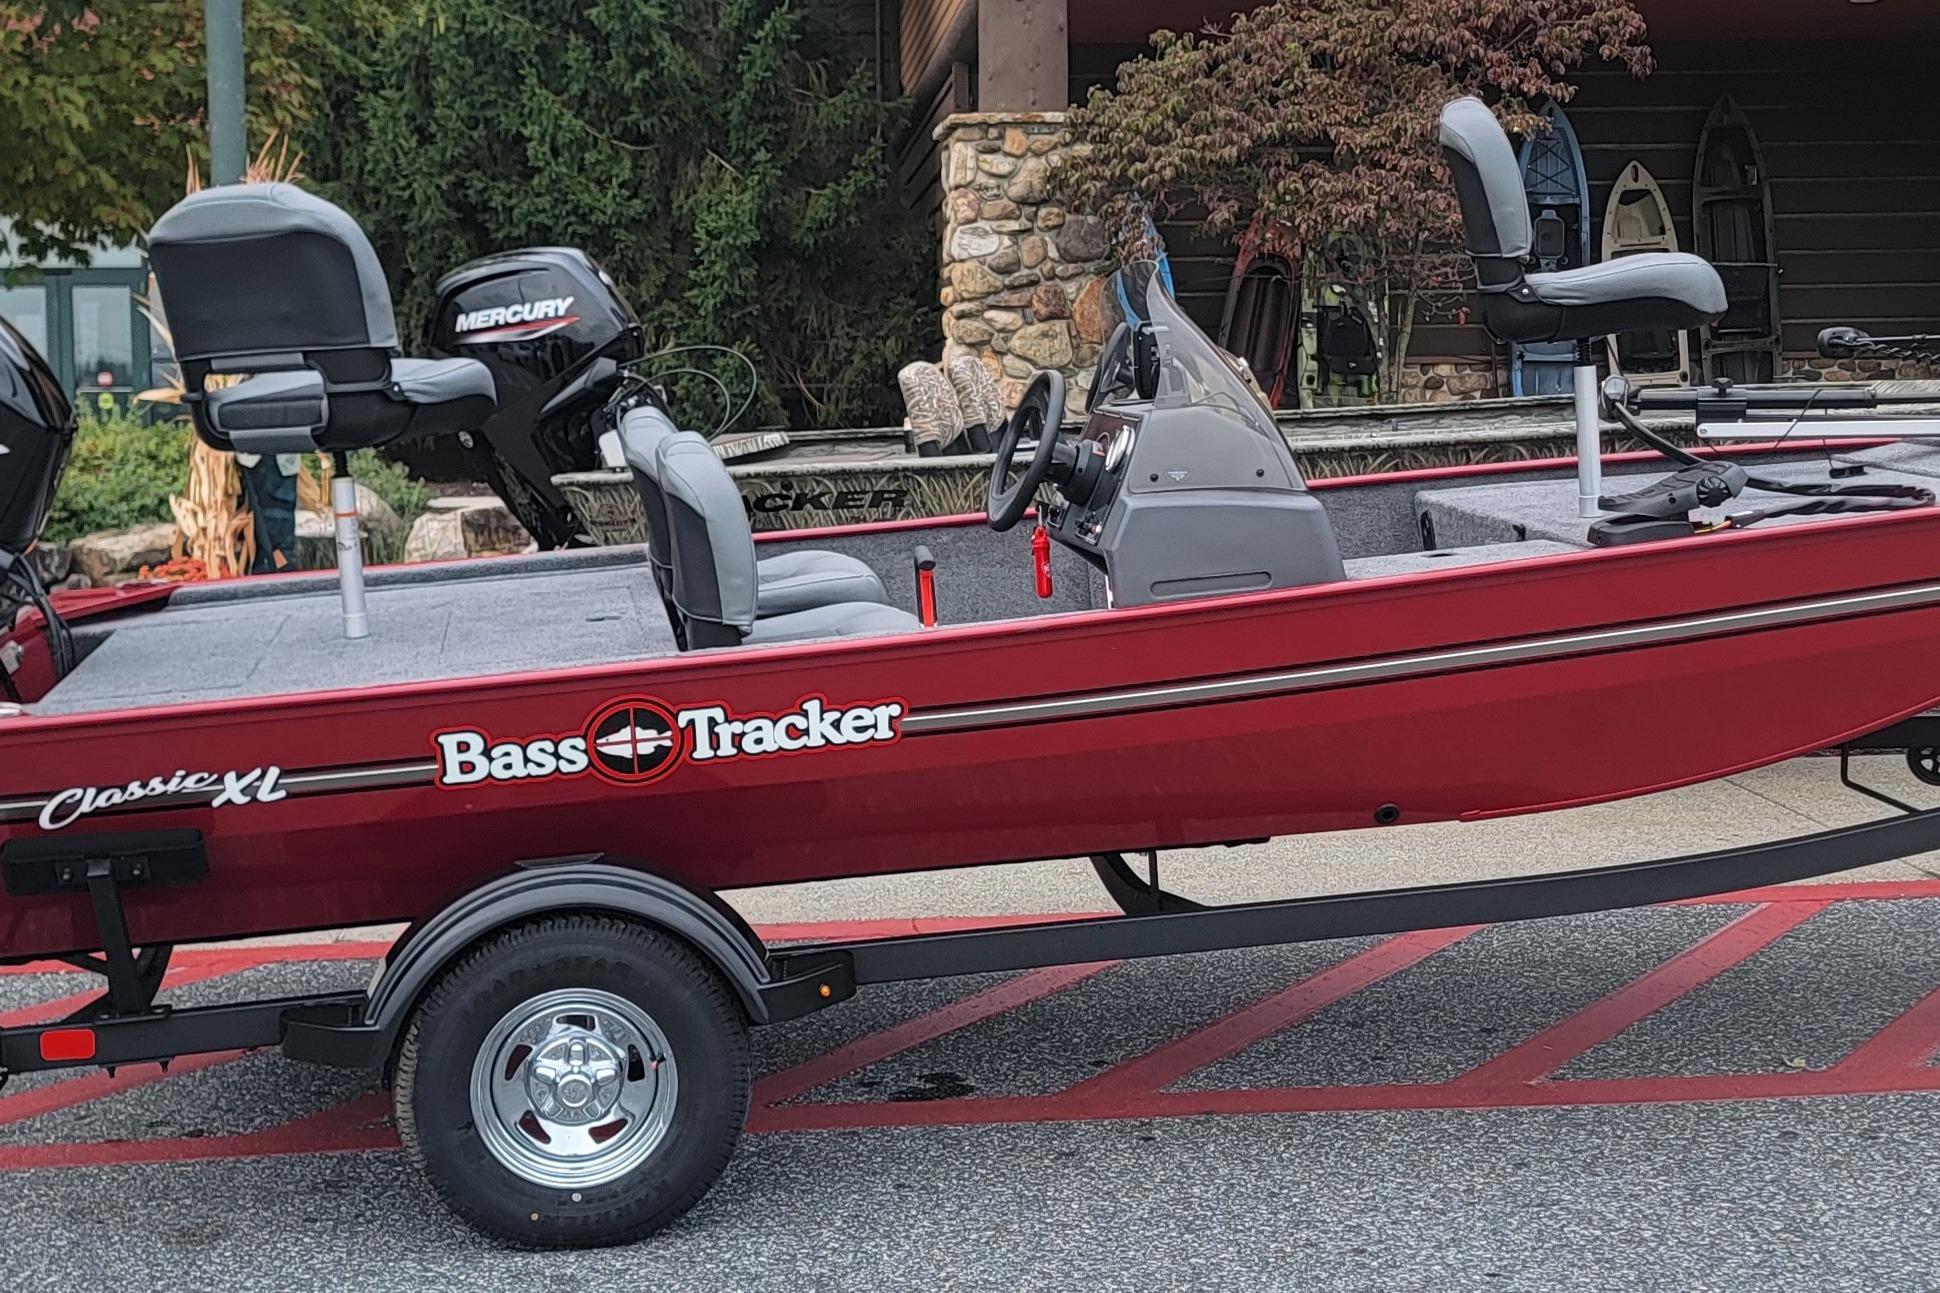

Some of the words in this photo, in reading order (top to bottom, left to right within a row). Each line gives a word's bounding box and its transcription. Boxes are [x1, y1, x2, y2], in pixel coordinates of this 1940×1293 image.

[455, 296, 575, 332] MERCURY
[437, 731, 590, 784] Bass
[677, 699, 902, 759] Tracker
[38, 769, 219, 830] Classic
[211, 766, 287, 808] XL
